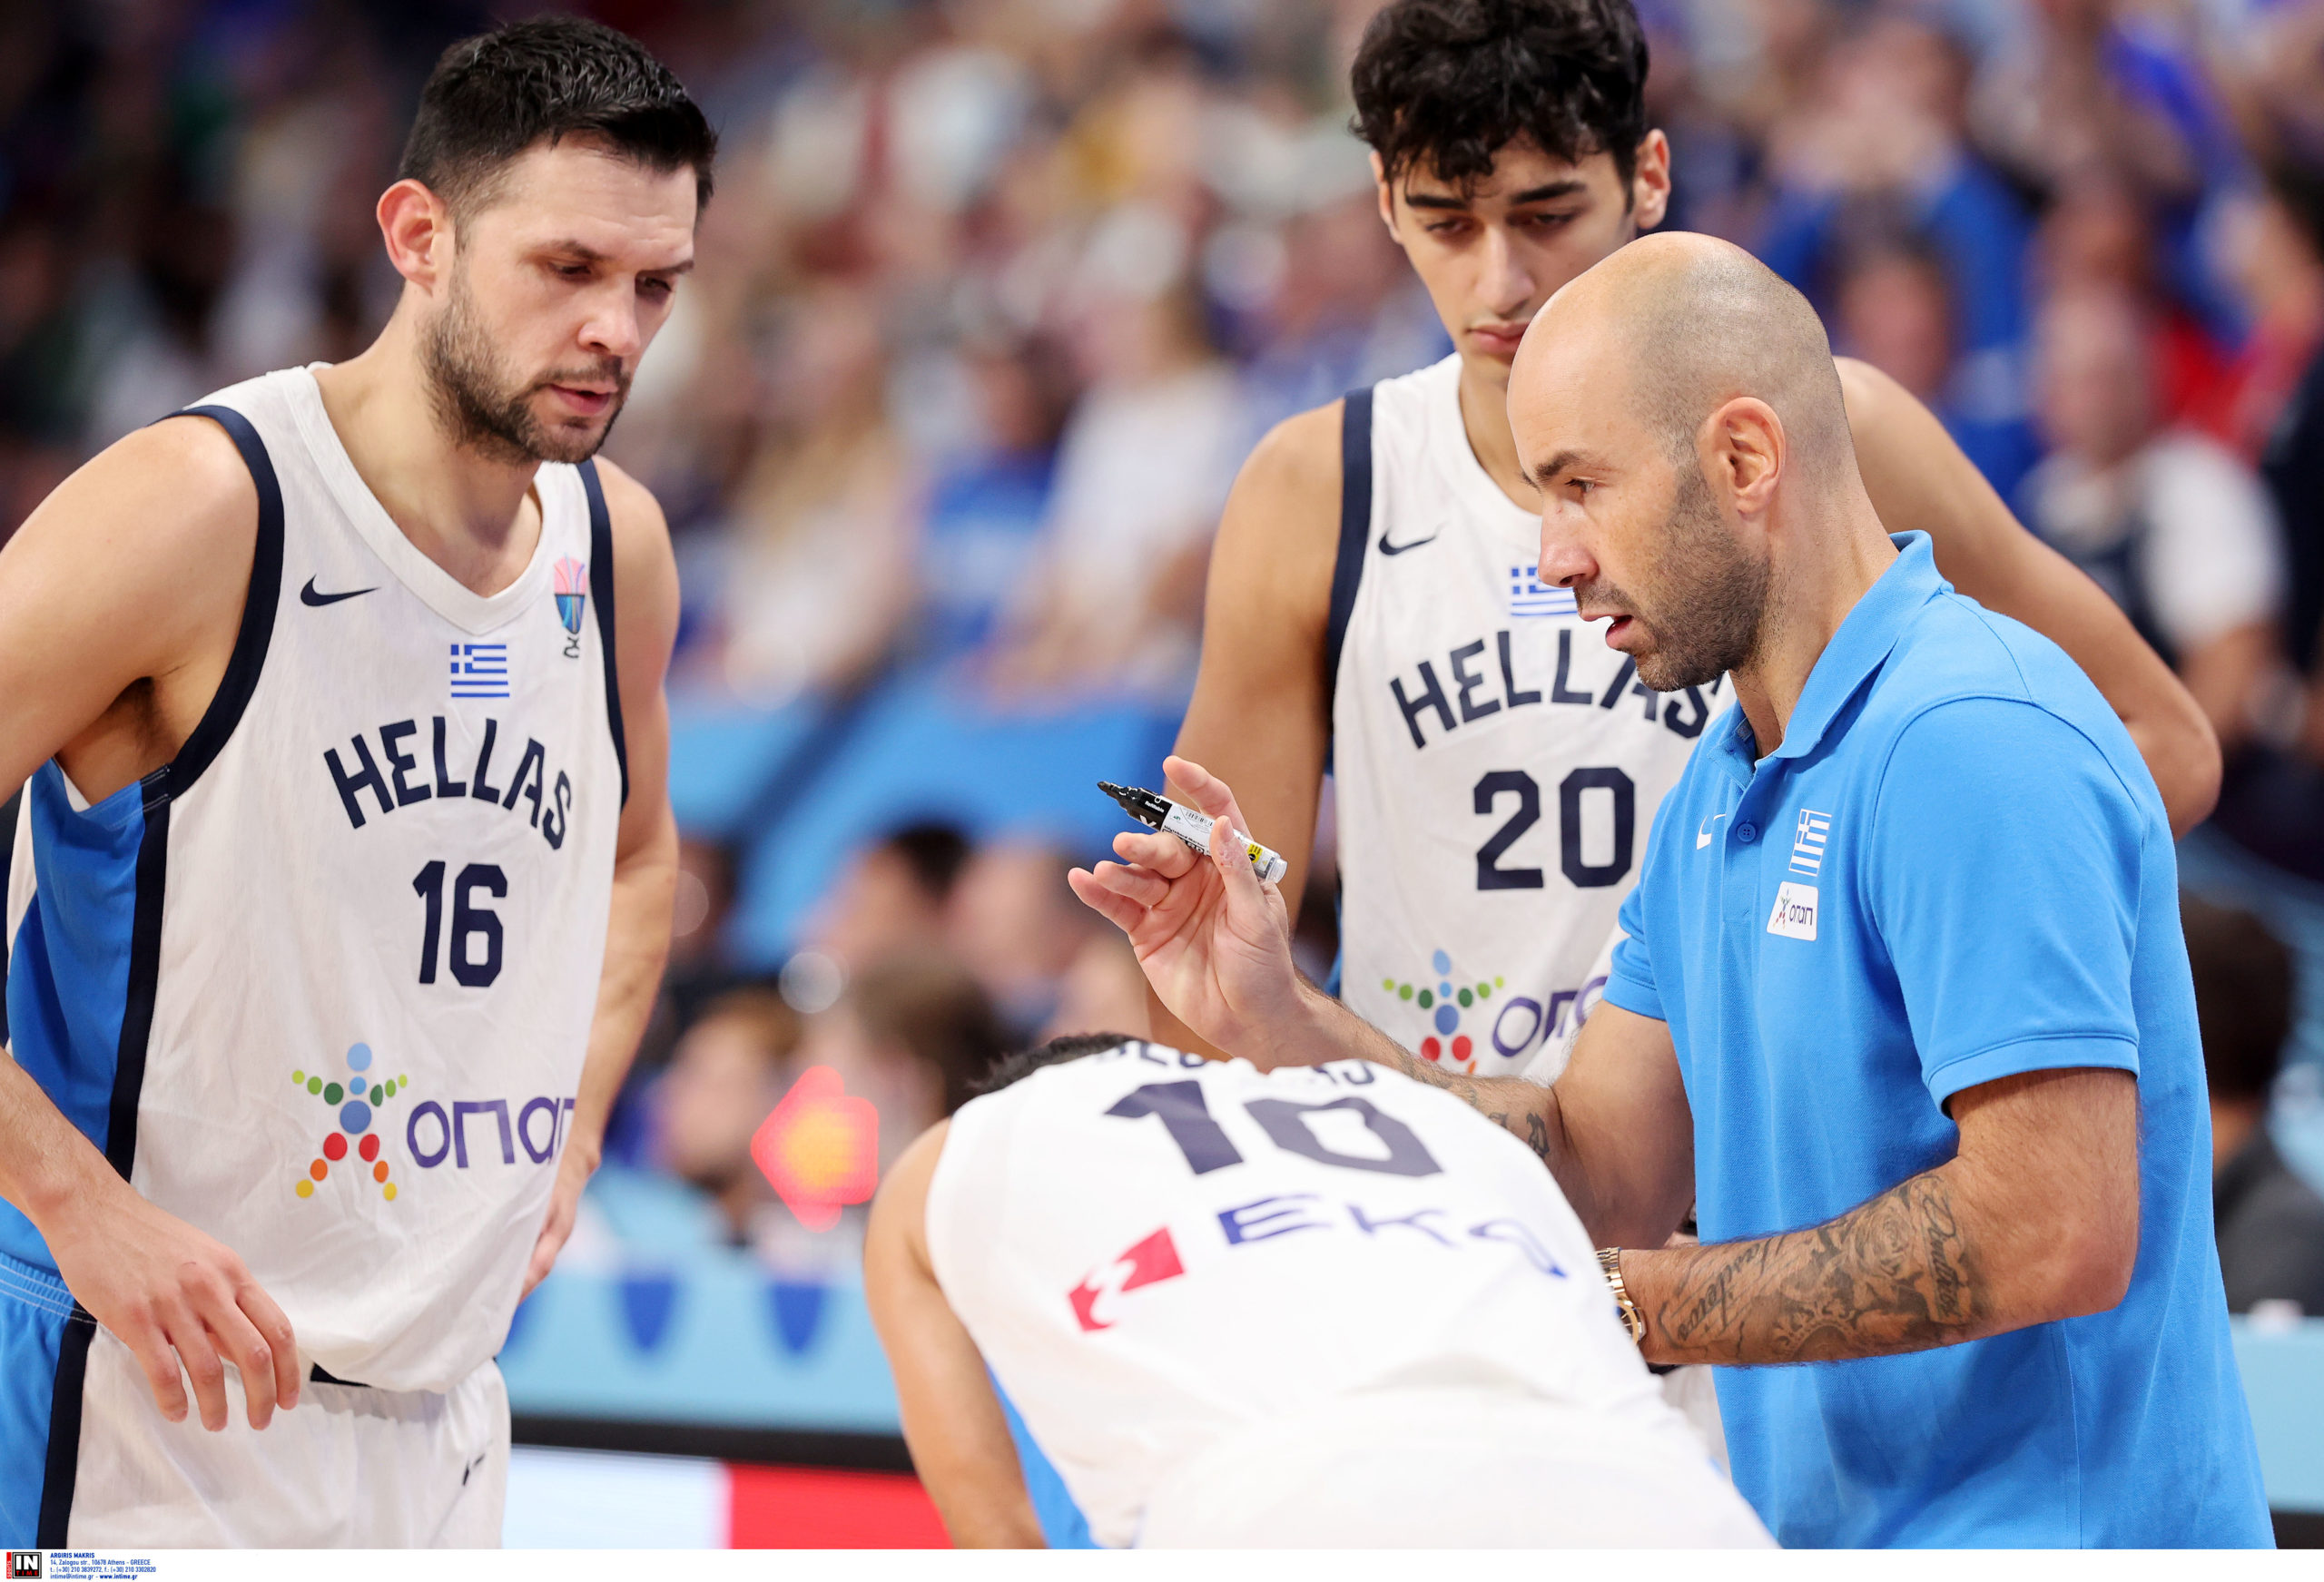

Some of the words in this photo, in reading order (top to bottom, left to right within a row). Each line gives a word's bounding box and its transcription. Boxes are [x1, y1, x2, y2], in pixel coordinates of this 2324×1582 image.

[324, 716, 571, 850] HELLAS
[1473, 767, 1635, 890] 20
[413, 860, 507, 987] 16
[1104, 1080, 1444, 1177] 10
